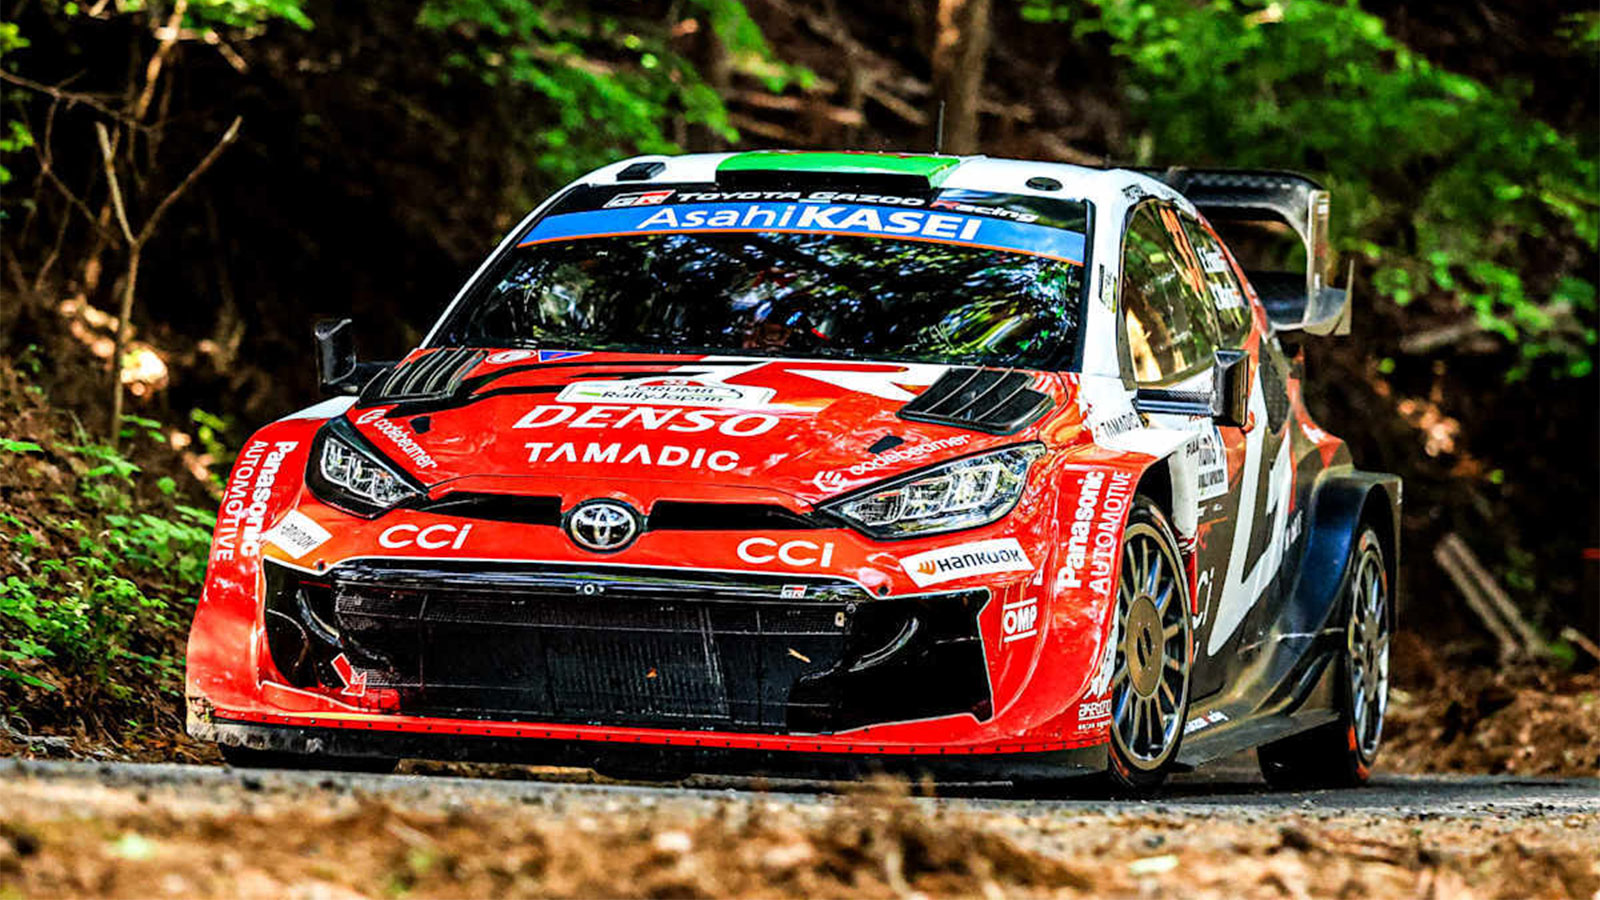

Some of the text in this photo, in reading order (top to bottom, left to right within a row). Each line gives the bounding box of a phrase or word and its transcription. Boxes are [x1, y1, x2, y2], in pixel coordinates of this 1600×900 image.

[677, 191, 800, 202] TOYOTA
[808, 191, 926, 206] GAZOO
[929, 199, 1040, 223] Racing
[512, 405, 780, 437] DENSO
[372, 418, 438, 469] codebeamer
[523, 441, 740, 472] TAMADIC
[850, 434, 971, 476] codebeamer
[215, 439, 268, 562] AUTOMOTIVE
[240, 440, 299, 556] Panasonic
[378, 523, 474, 550] CCI
[1056, 471, 1106, 589] Panasonic
[1088, 470, 1132, 595] AUTOMOTIVE
[736, 537, 835, 569] CCI
[1002, 605, 1038, 635] OMP
